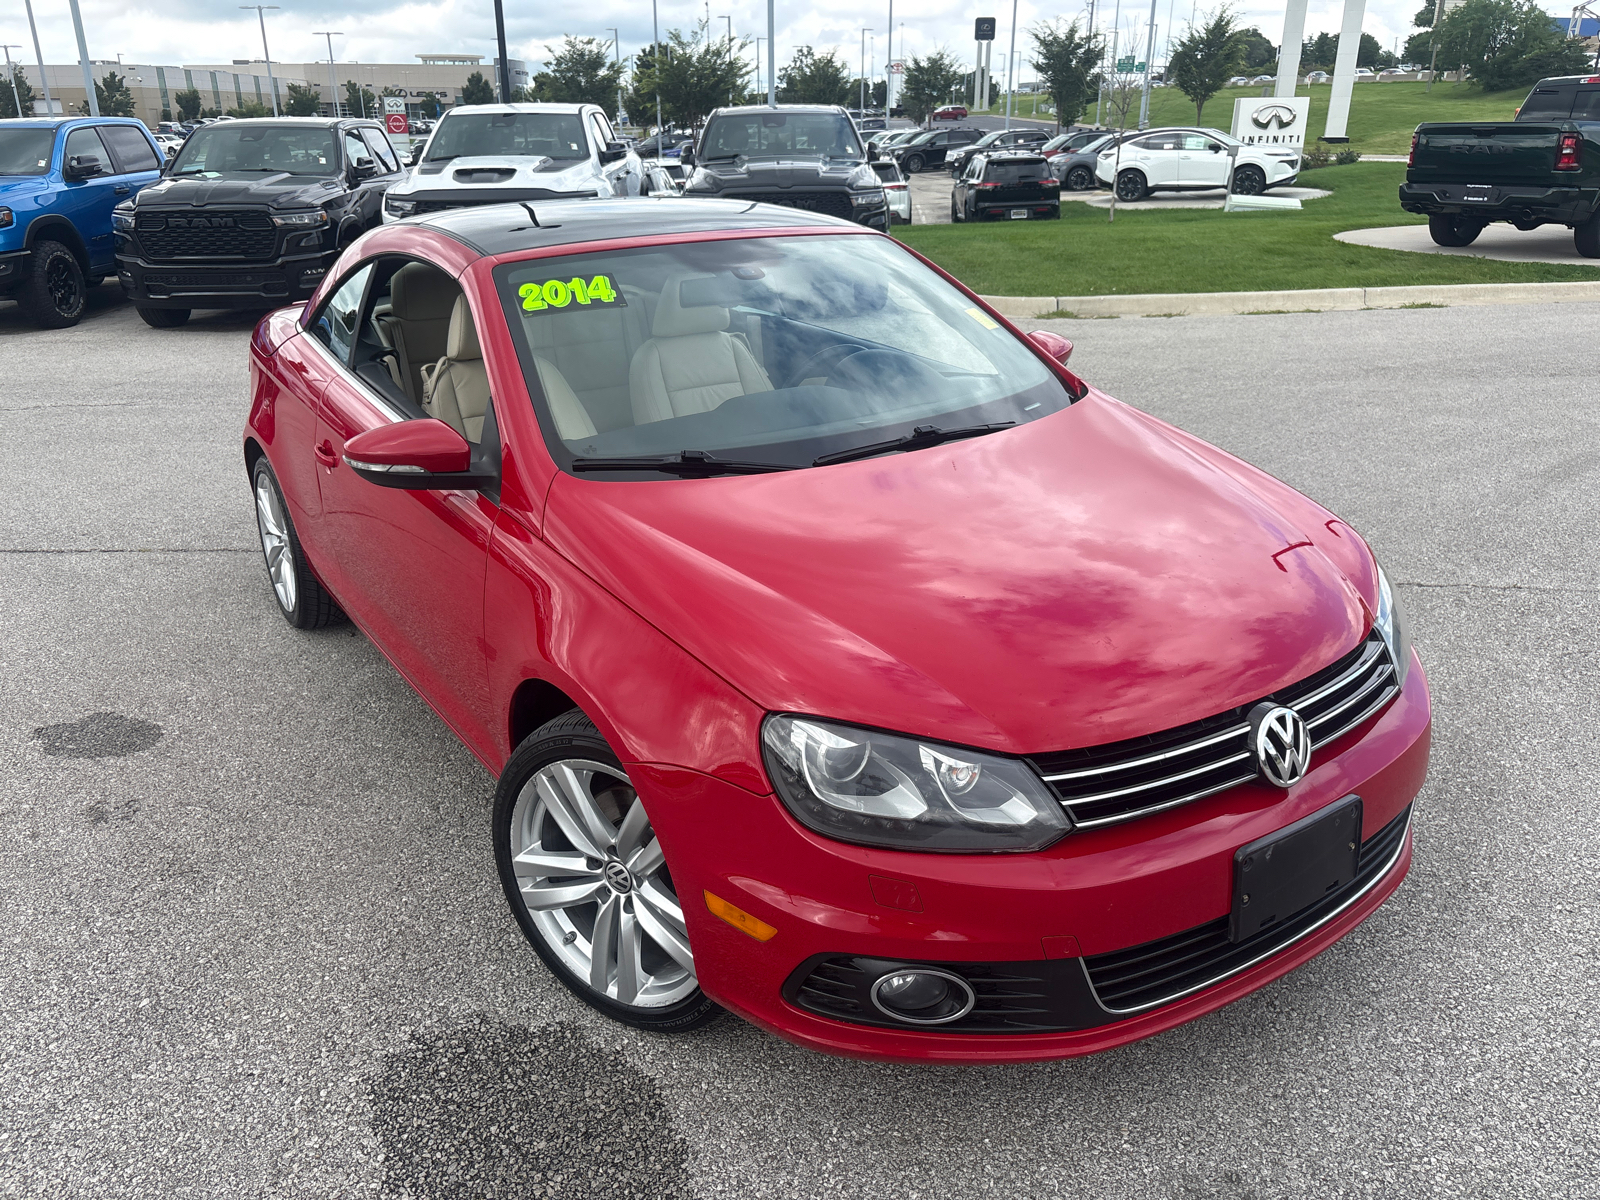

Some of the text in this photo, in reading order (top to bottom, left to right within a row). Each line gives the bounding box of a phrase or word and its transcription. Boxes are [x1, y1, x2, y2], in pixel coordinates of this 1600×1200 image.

[1242, 134, 1300, 143] INFINITI
[1449, 145, 1514, 155] RAM
[167, 217, 235, 228] RAM
[518, 275, 617, 312] 2014
[656, 1011, 699, 1028] FIREHAWK
